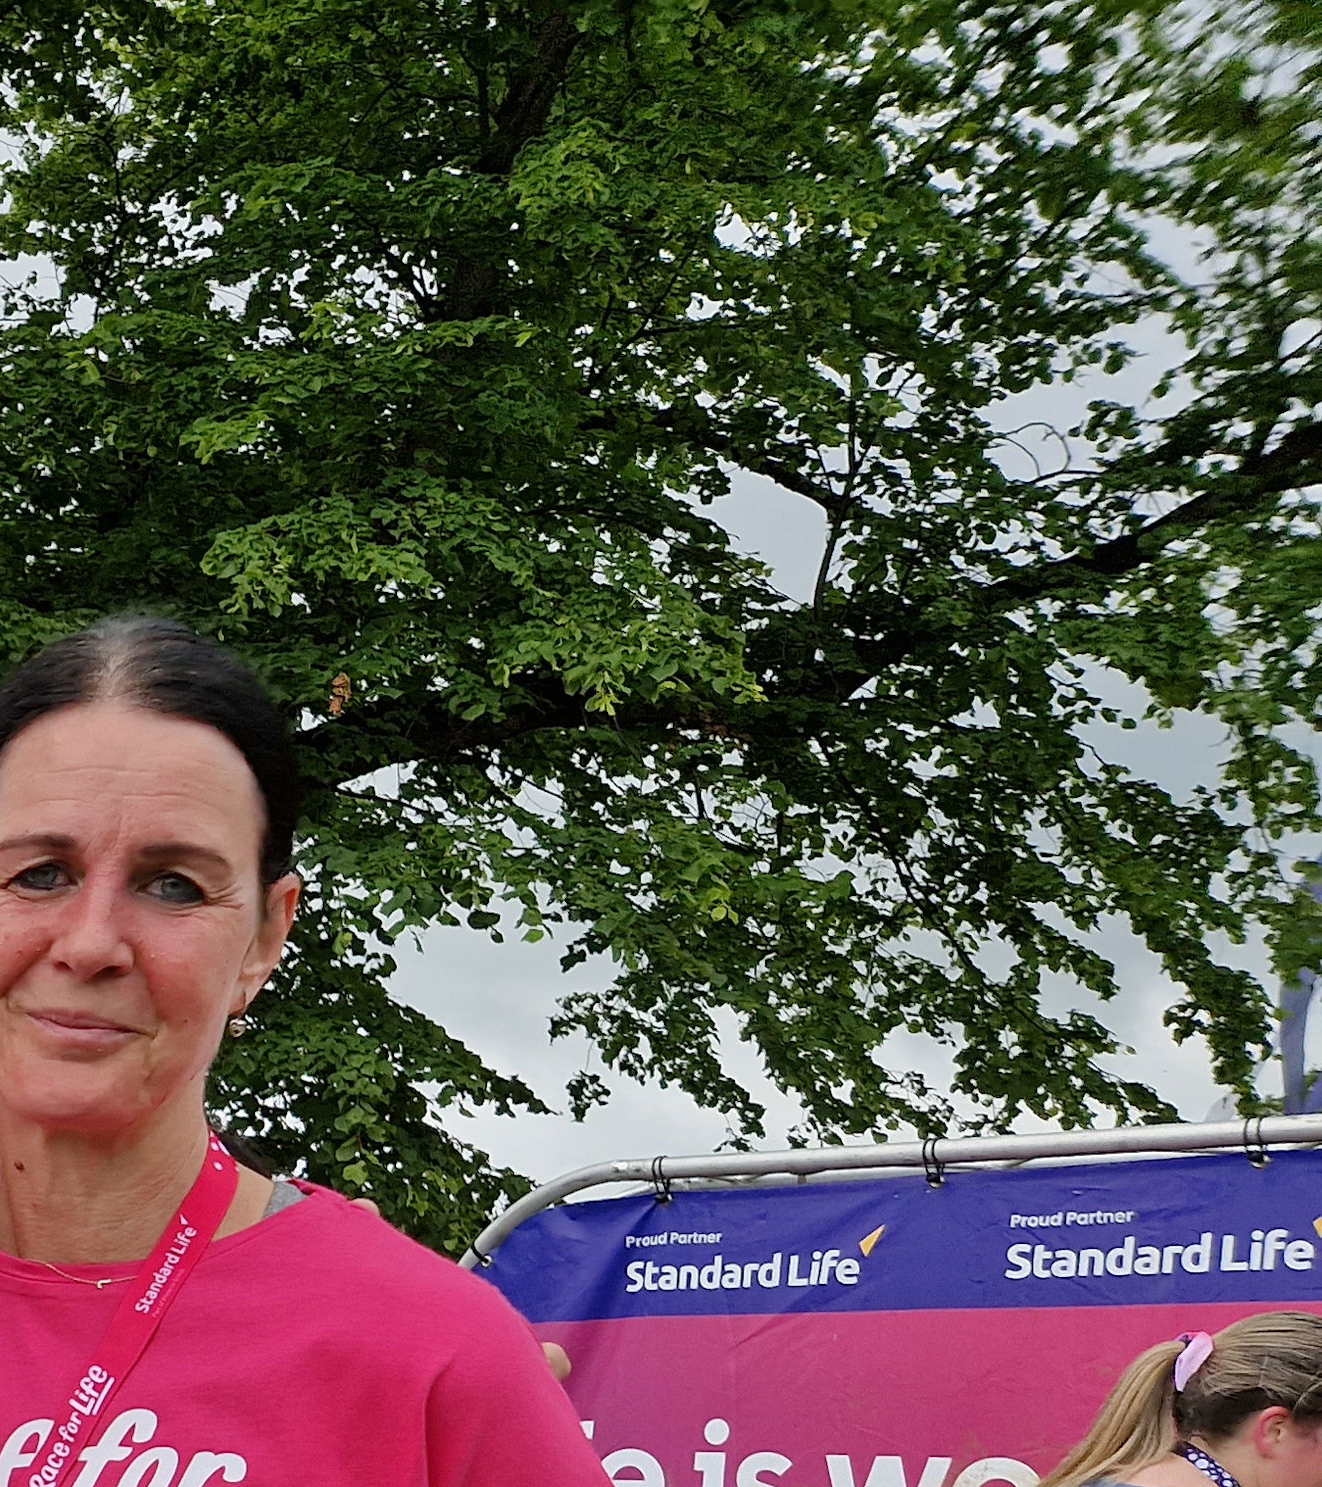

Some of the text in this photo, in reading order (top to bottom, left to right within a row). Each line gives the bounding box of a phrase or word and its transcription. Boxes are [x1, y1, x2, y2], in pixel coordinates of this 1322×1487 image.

[625, 1231, 723, 1248] Proud Partner
[1010, 1207, 1135, 1229] Proud Partner
[135, 1222, 196, 1313] Standard Life
[625, 1249, 861, 1293] Standard Life
[1005, 1227, 1315, 1281] Standard Life
[69, 1366, 111, 1415] Life
[59, 1412, 81, 1442] for
